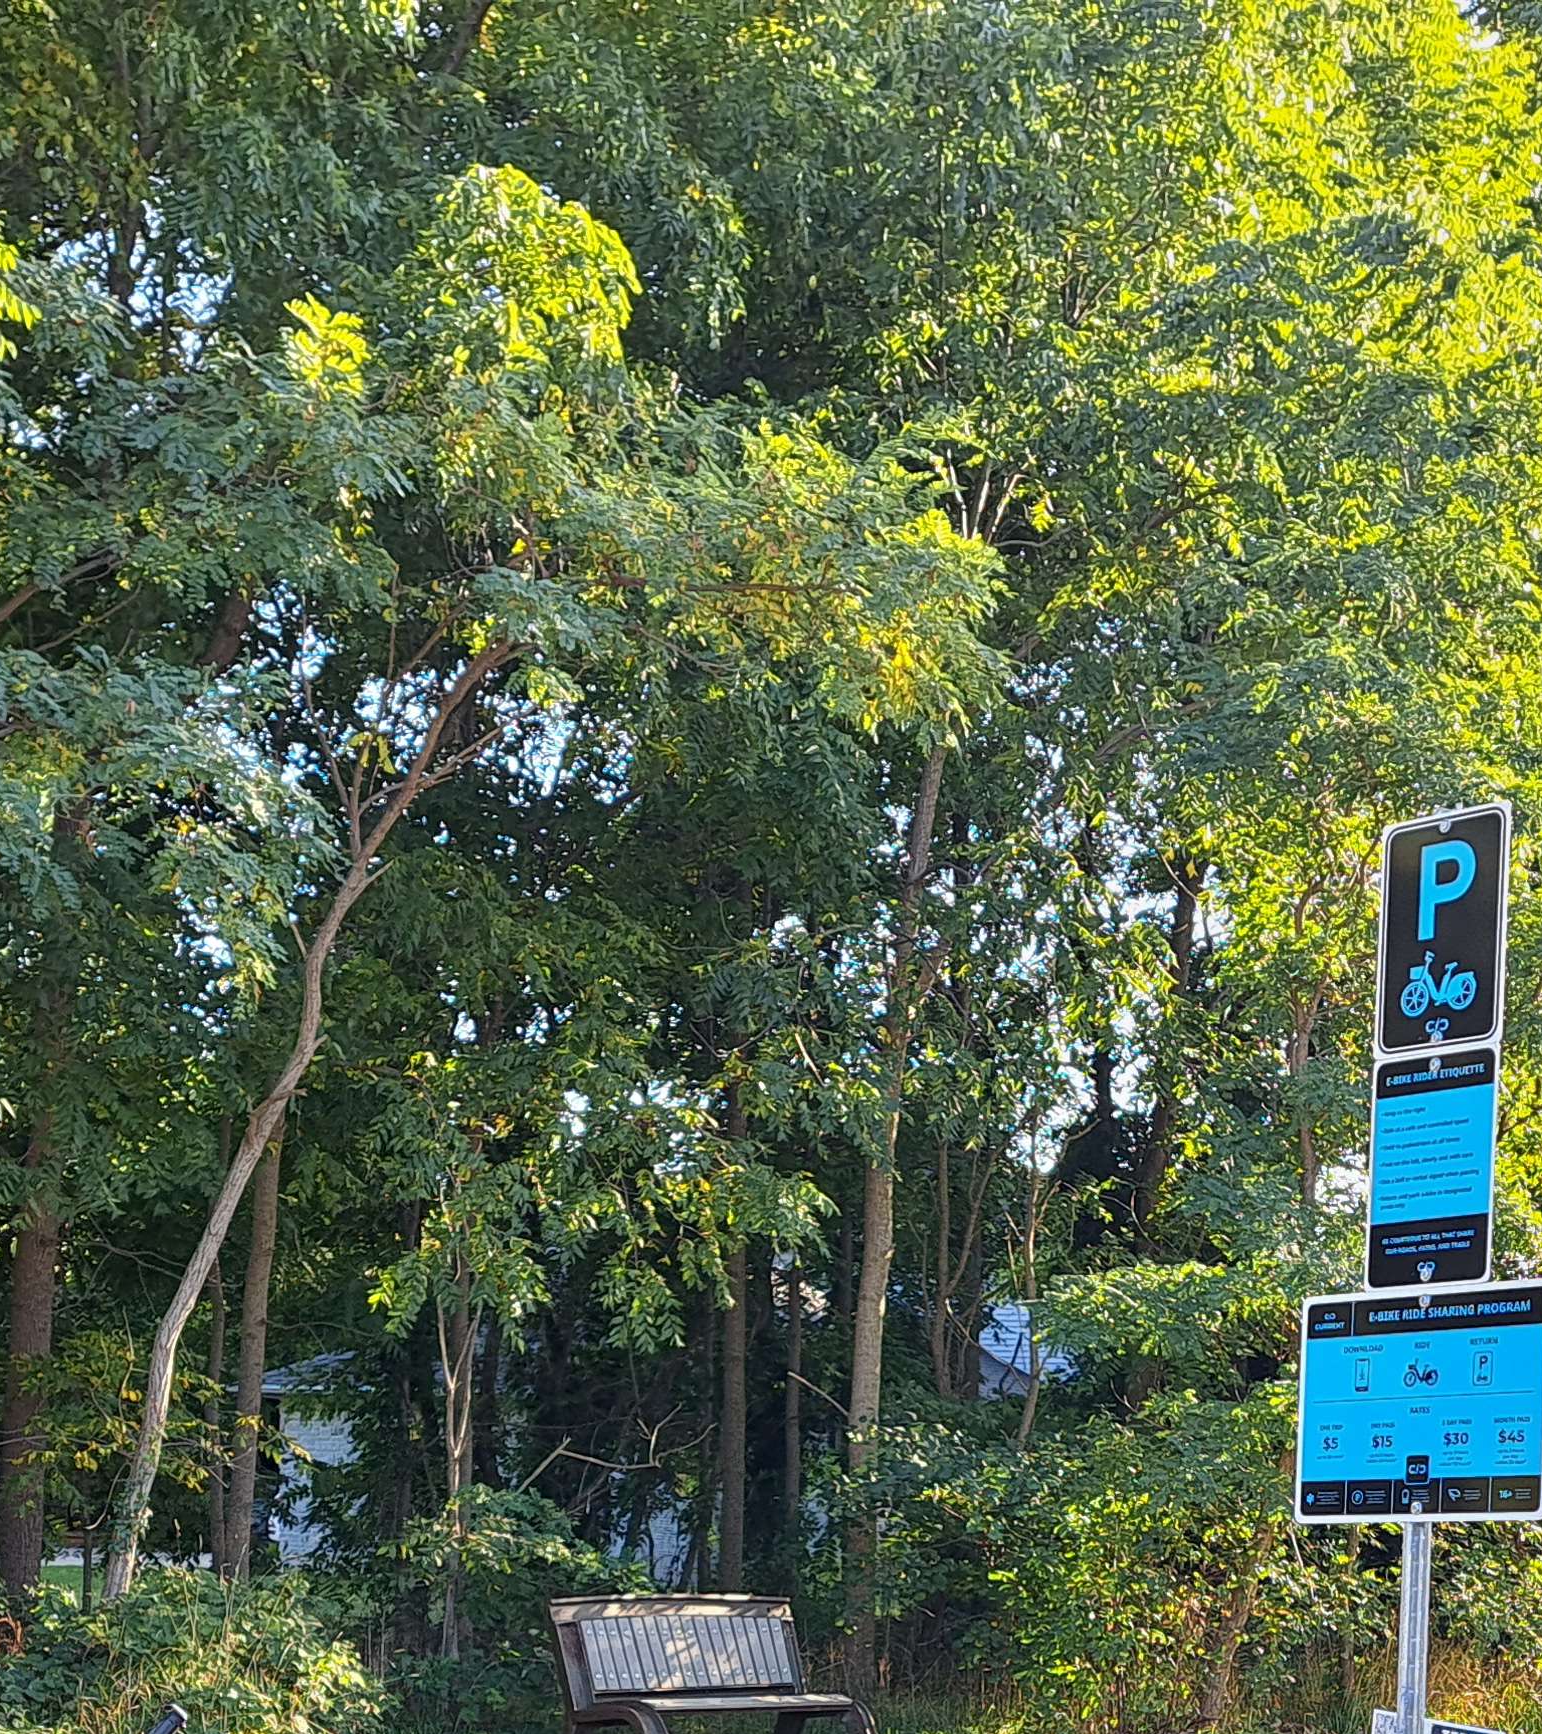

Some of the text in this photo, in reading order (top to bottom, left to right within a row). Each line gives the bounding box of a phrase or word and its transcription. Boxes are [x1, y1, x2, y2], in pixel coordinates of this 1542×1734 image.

[1417, 839, 1476, 941] P
[1386, 1063, 1485, 1087] E-BIKE RIDER ETIQUETTE
[1369, 1299, 1531, 1322] E-BIKE RIDE SHARING PROGRAM
[1343, 1344, 1384, 1354] DOWNLOAD
[1372, 1434, 1393, 1449] $15
[1443, 1431, 1469, 1447] $30
[1498, 1428, 1525, 1443] $45
[1322, 1436, 1339, 1451] $5
